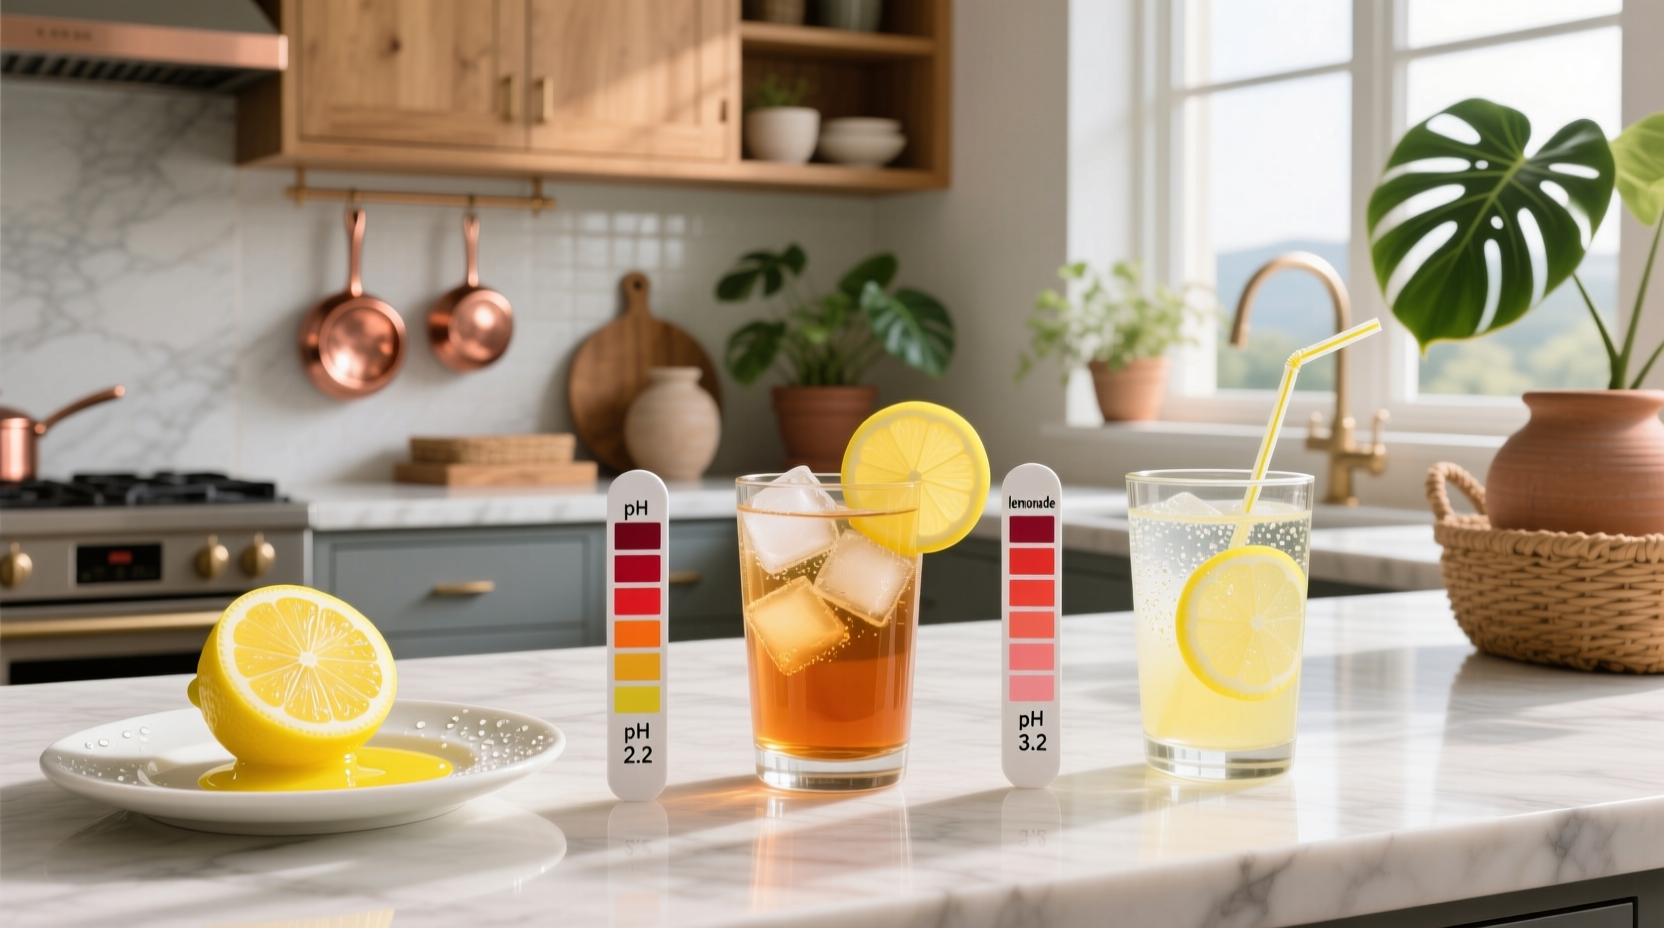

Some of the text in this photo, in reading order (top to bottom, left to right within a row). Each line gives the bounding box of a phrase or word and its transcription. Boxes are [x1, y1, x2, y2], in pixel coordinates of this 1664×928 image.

[624, 499, 648, 520] pH
[1008, 495, 1056, 509] lemonade
[1018, 709, 1045, 731] pH
[623, 721, 650, 744] pH
[1018, 733, 1047, 752] 3.2
[623, 745, 653, 764] 2.2
